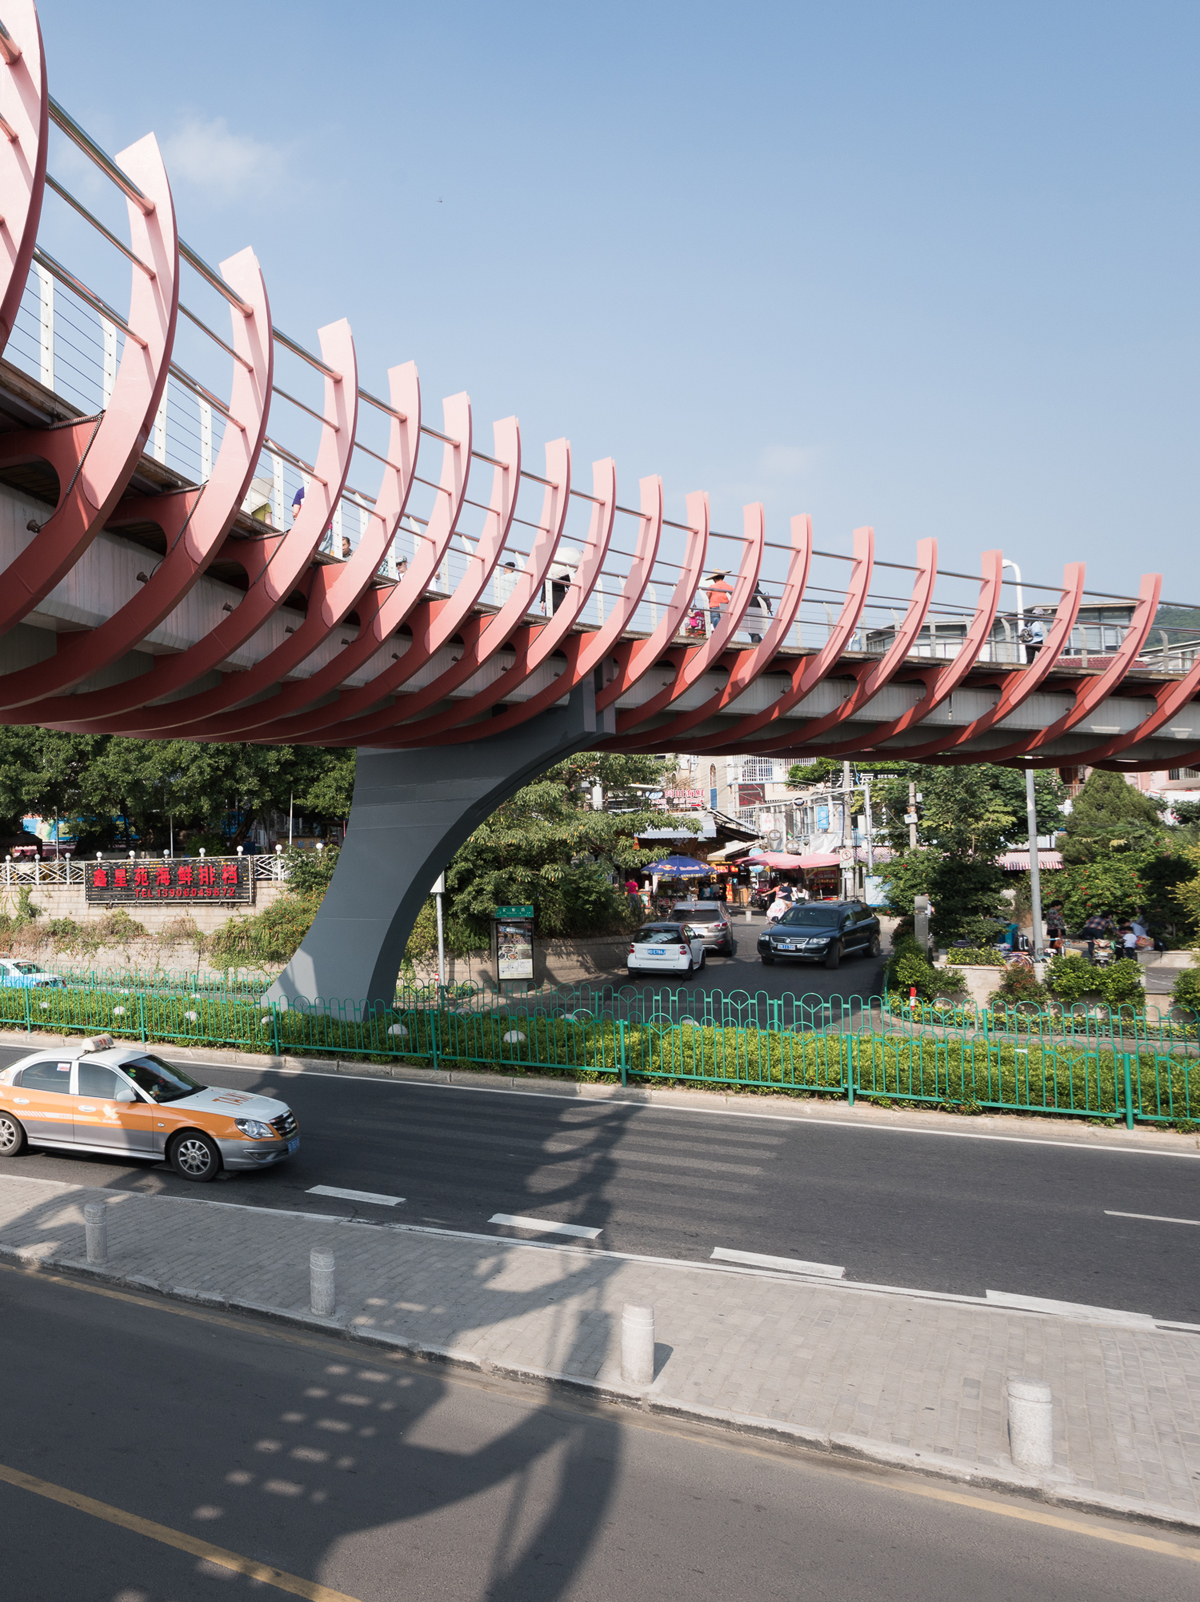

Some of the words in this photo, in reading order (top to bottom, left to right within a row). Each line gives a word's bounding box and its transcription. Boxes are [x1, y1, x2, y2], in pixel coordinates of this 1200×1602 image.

[93, 864, 238, 887] 鑫星苑海鲜排档
[134, 888, 153, 898] TEL
[157, 887, 235, 897] 13906049672
